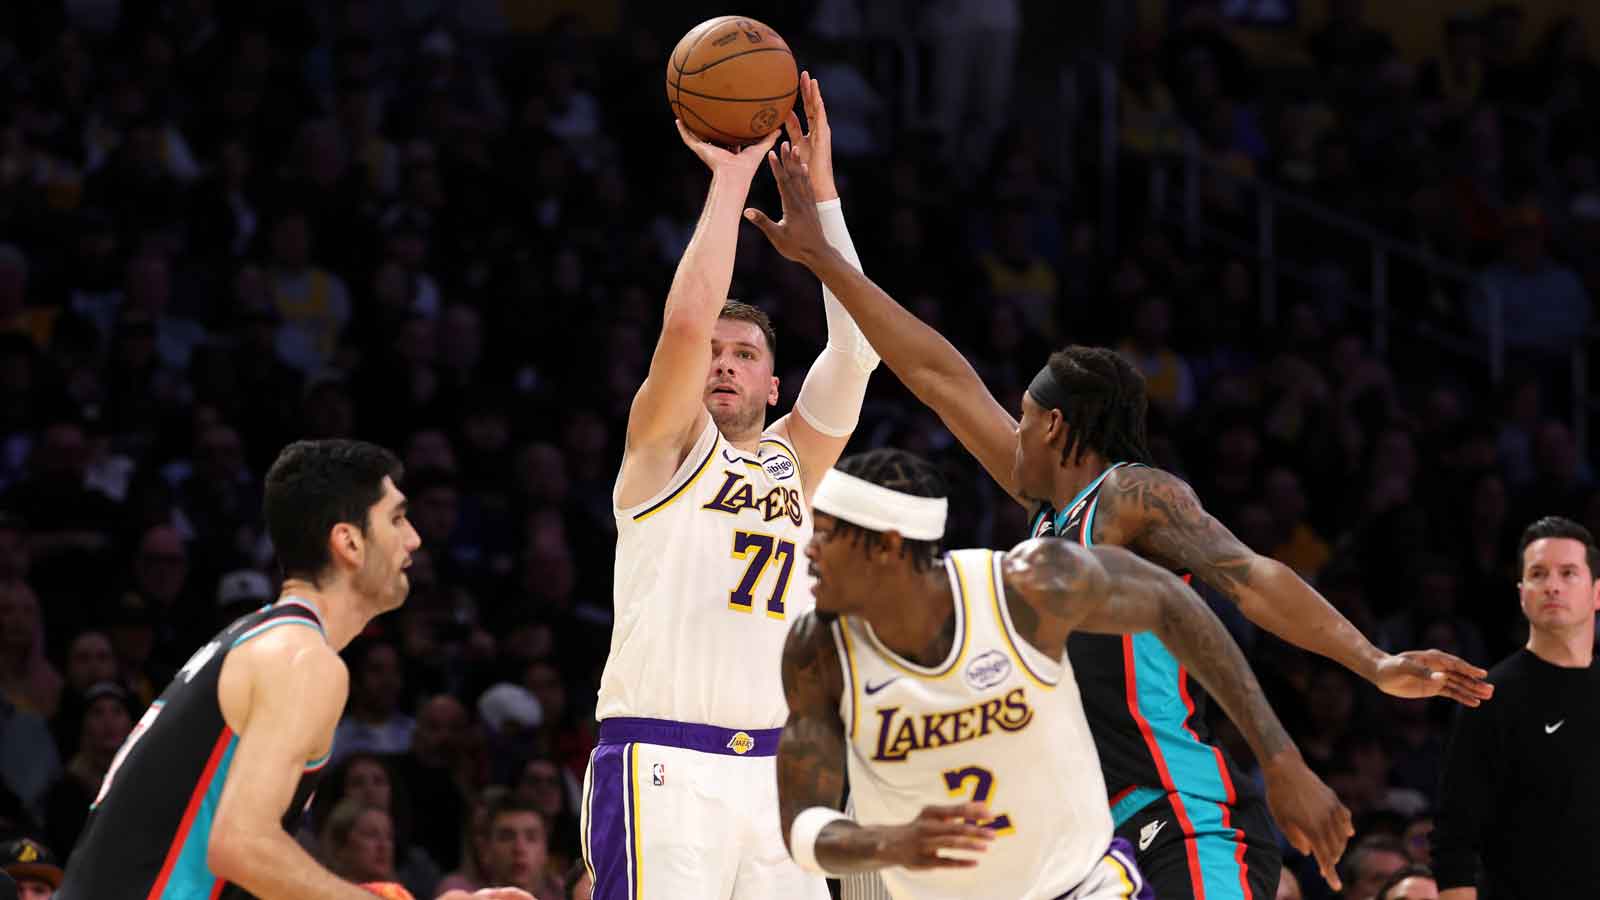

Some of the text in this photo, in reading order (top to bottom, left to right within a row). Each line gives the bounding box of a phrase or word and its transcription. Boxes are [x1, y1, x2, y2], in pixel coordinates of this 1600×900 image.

[702, 469, 803, 527] LAERS
[729, 530, 796, 619] 77
[871, 688, 1034, 762] LAKERS
[943, 765, 1014, 835] 2
